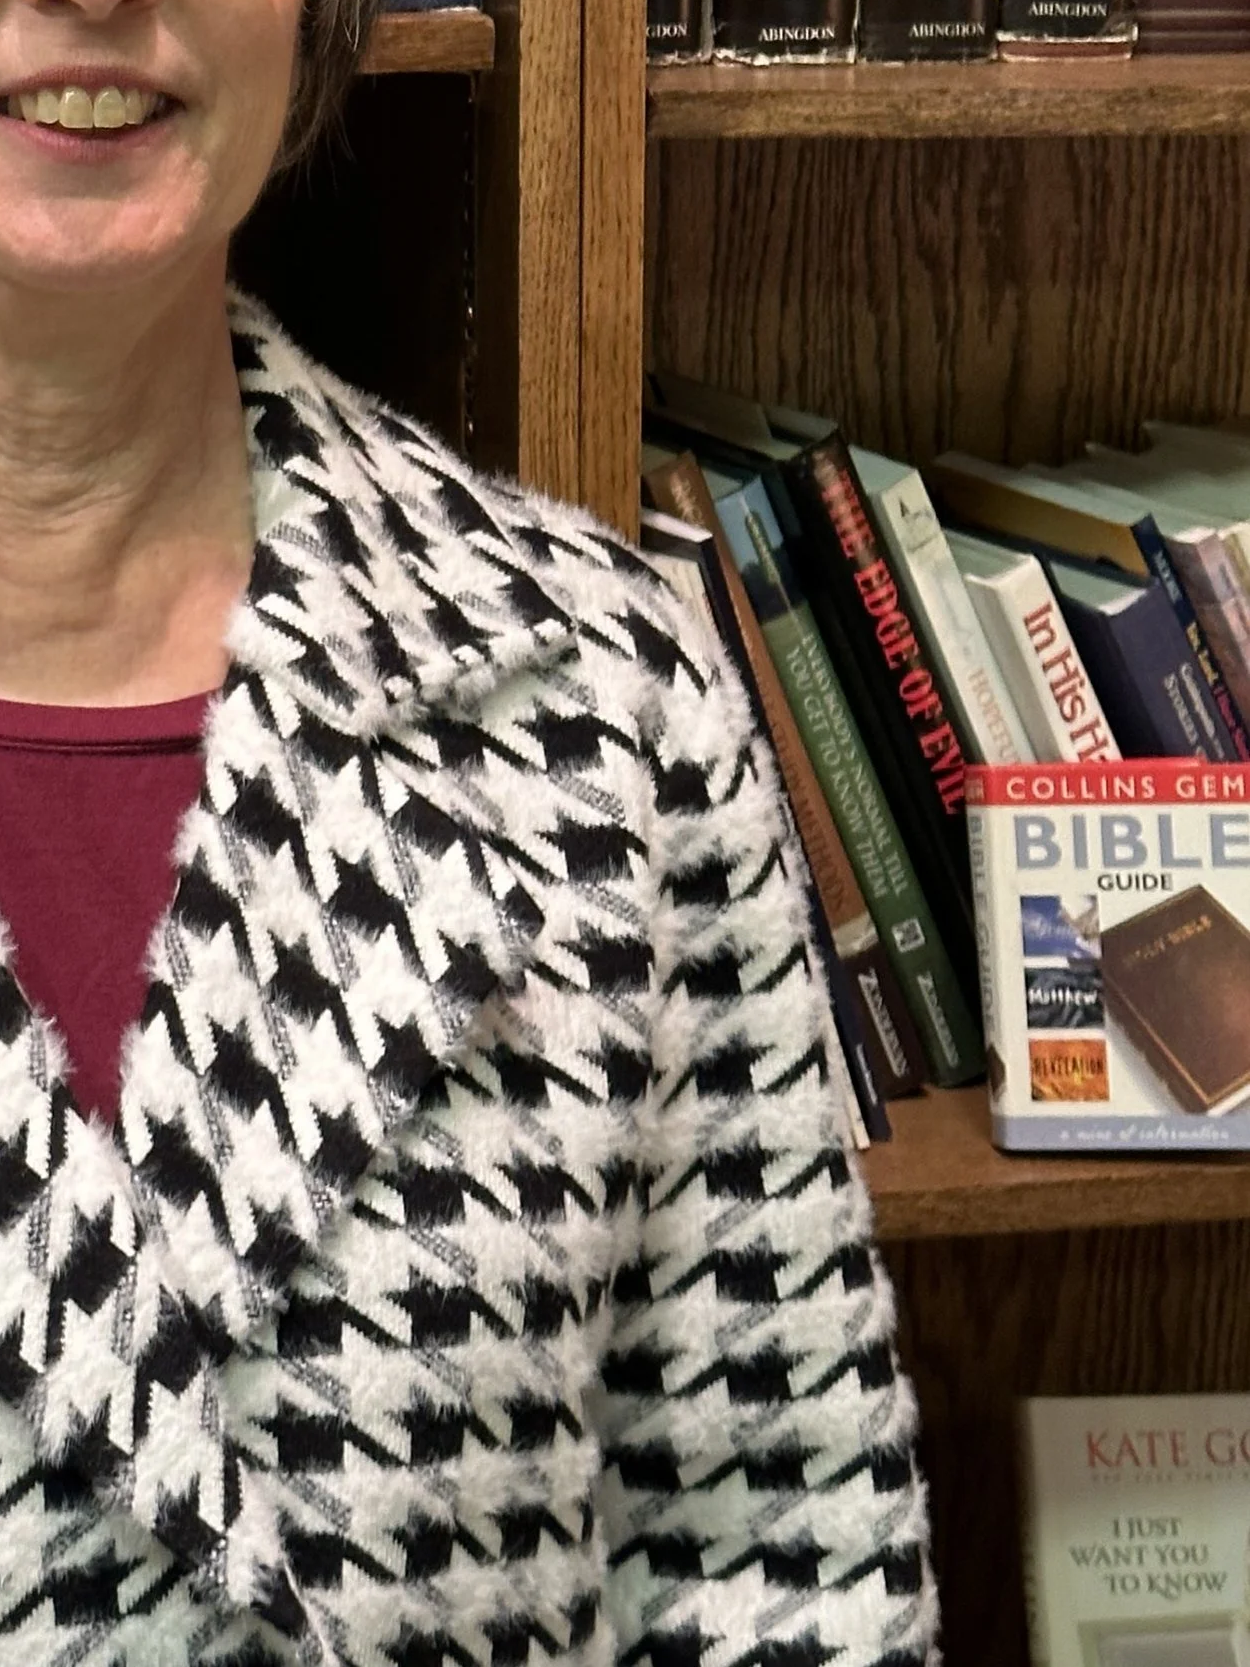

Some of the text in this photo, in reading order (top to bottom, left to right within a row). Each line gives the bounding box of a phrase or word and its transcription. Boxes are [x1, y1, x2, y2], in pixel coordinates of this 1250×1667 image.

[1028, 1, 1107, 18] ABINGDON
[758, 25, 836, 42] ABINGDON
[909, 22, 986, 38] ABINGDON
[854, 558, 919, 670] EDGE
[1023, 602, 1087, 723] In His
[899, 666, 944, 720] OF
[803, 695, 832, 734] GET
[816, 735, 841, 766] TO
[919, 721, 966, 815] EVIL
[1006, 775, 1156, 800] COLLINS
[1176, 774, 1245, 799] GEM
[1013, 812, 1250, 870] BIBLE
[1097, 873, 1174, 892] GUIDE
[1086, 1430, 1190, 1469] KATE
[1113, 1517, 1181, 1540] I JUST
[1068, 1542, 1210, 1568] WANT YOU
[1102, 1570, 1229, 1602] TO KNOW
